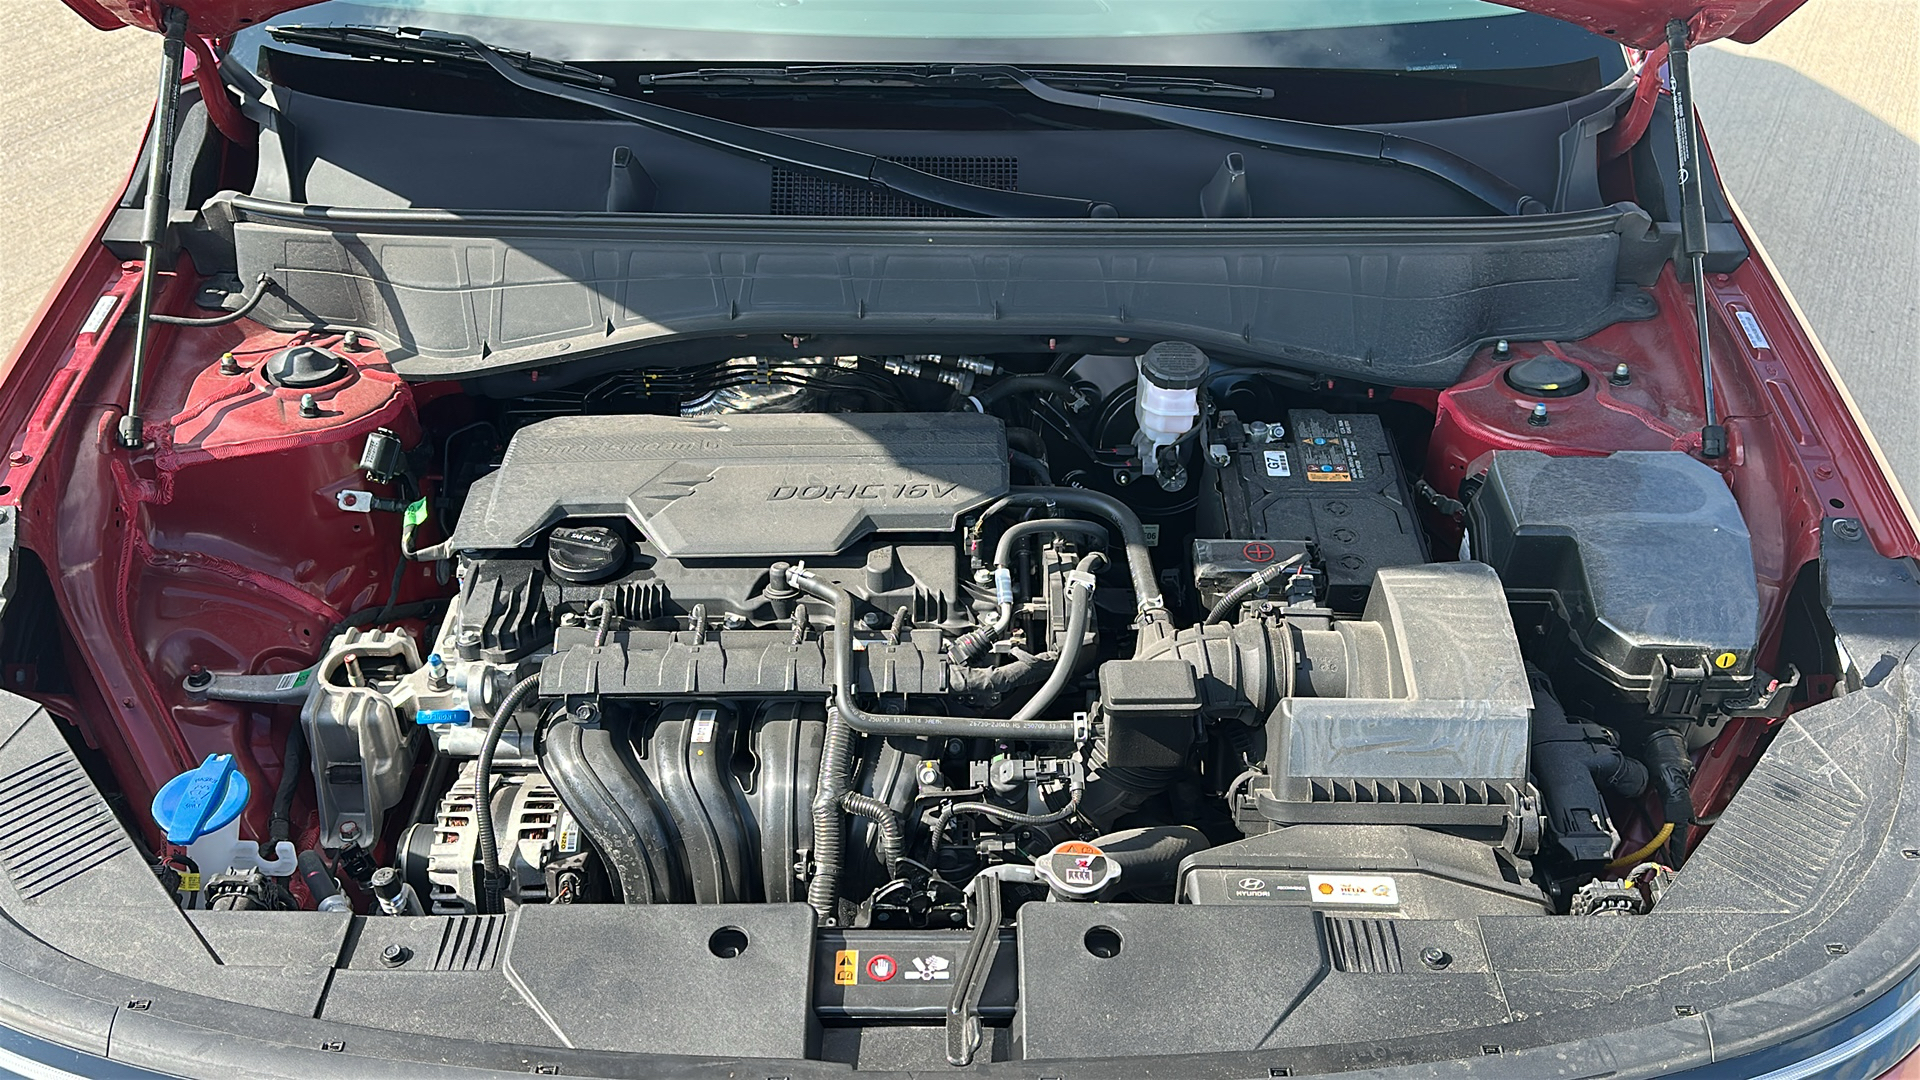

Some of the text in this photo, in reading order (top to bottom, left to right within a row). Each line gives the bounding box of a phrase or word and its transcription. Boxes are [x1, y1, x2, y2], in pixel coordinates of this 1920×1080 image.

[1267, 457, 1280, 469] G7
[767, 483, 960, 501] DOHC 16V
